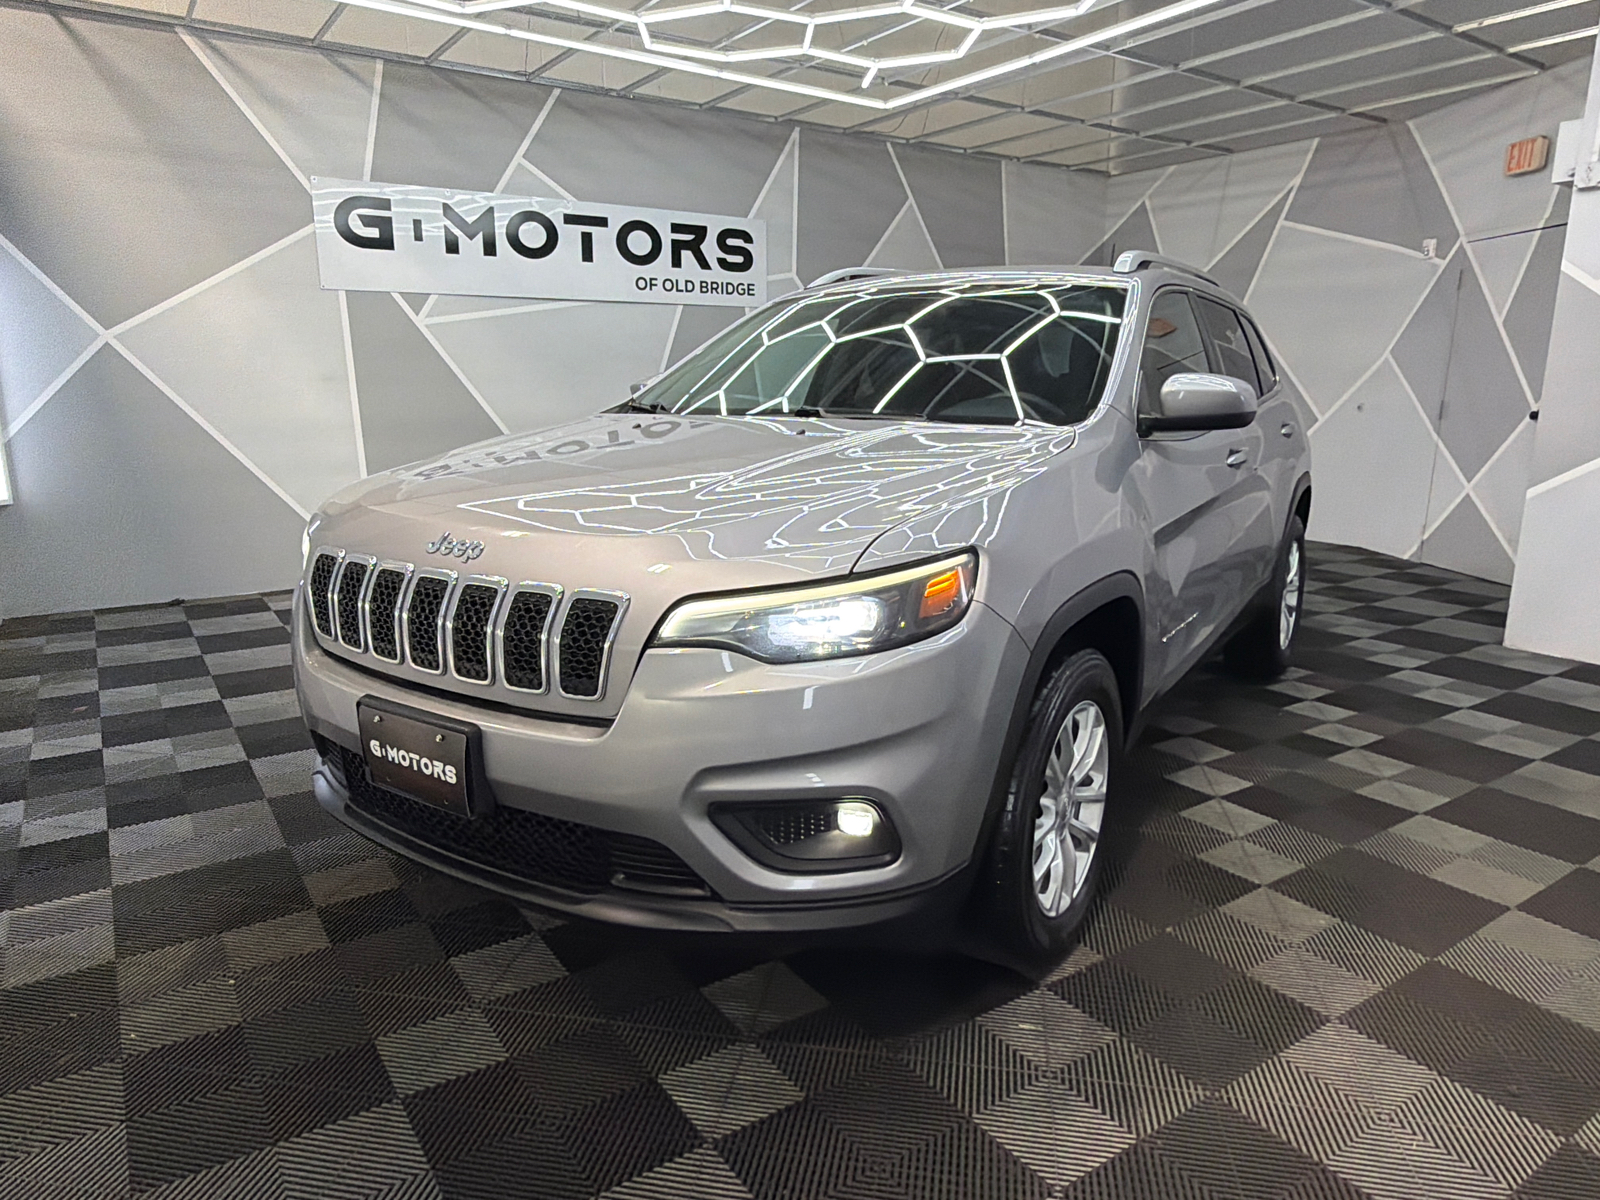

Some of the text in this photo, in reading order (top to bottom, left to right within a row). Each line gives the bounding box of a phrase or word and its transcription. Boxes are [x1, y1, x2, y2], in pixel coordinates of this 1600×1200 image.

[1507, 138, 1538, 172] EXIT
[635, 276, 756, 296] OF OLD BRIDGE
[426, 531, 485, 563] Jeep
[369, 739, 457, 784] G-MOTORS
